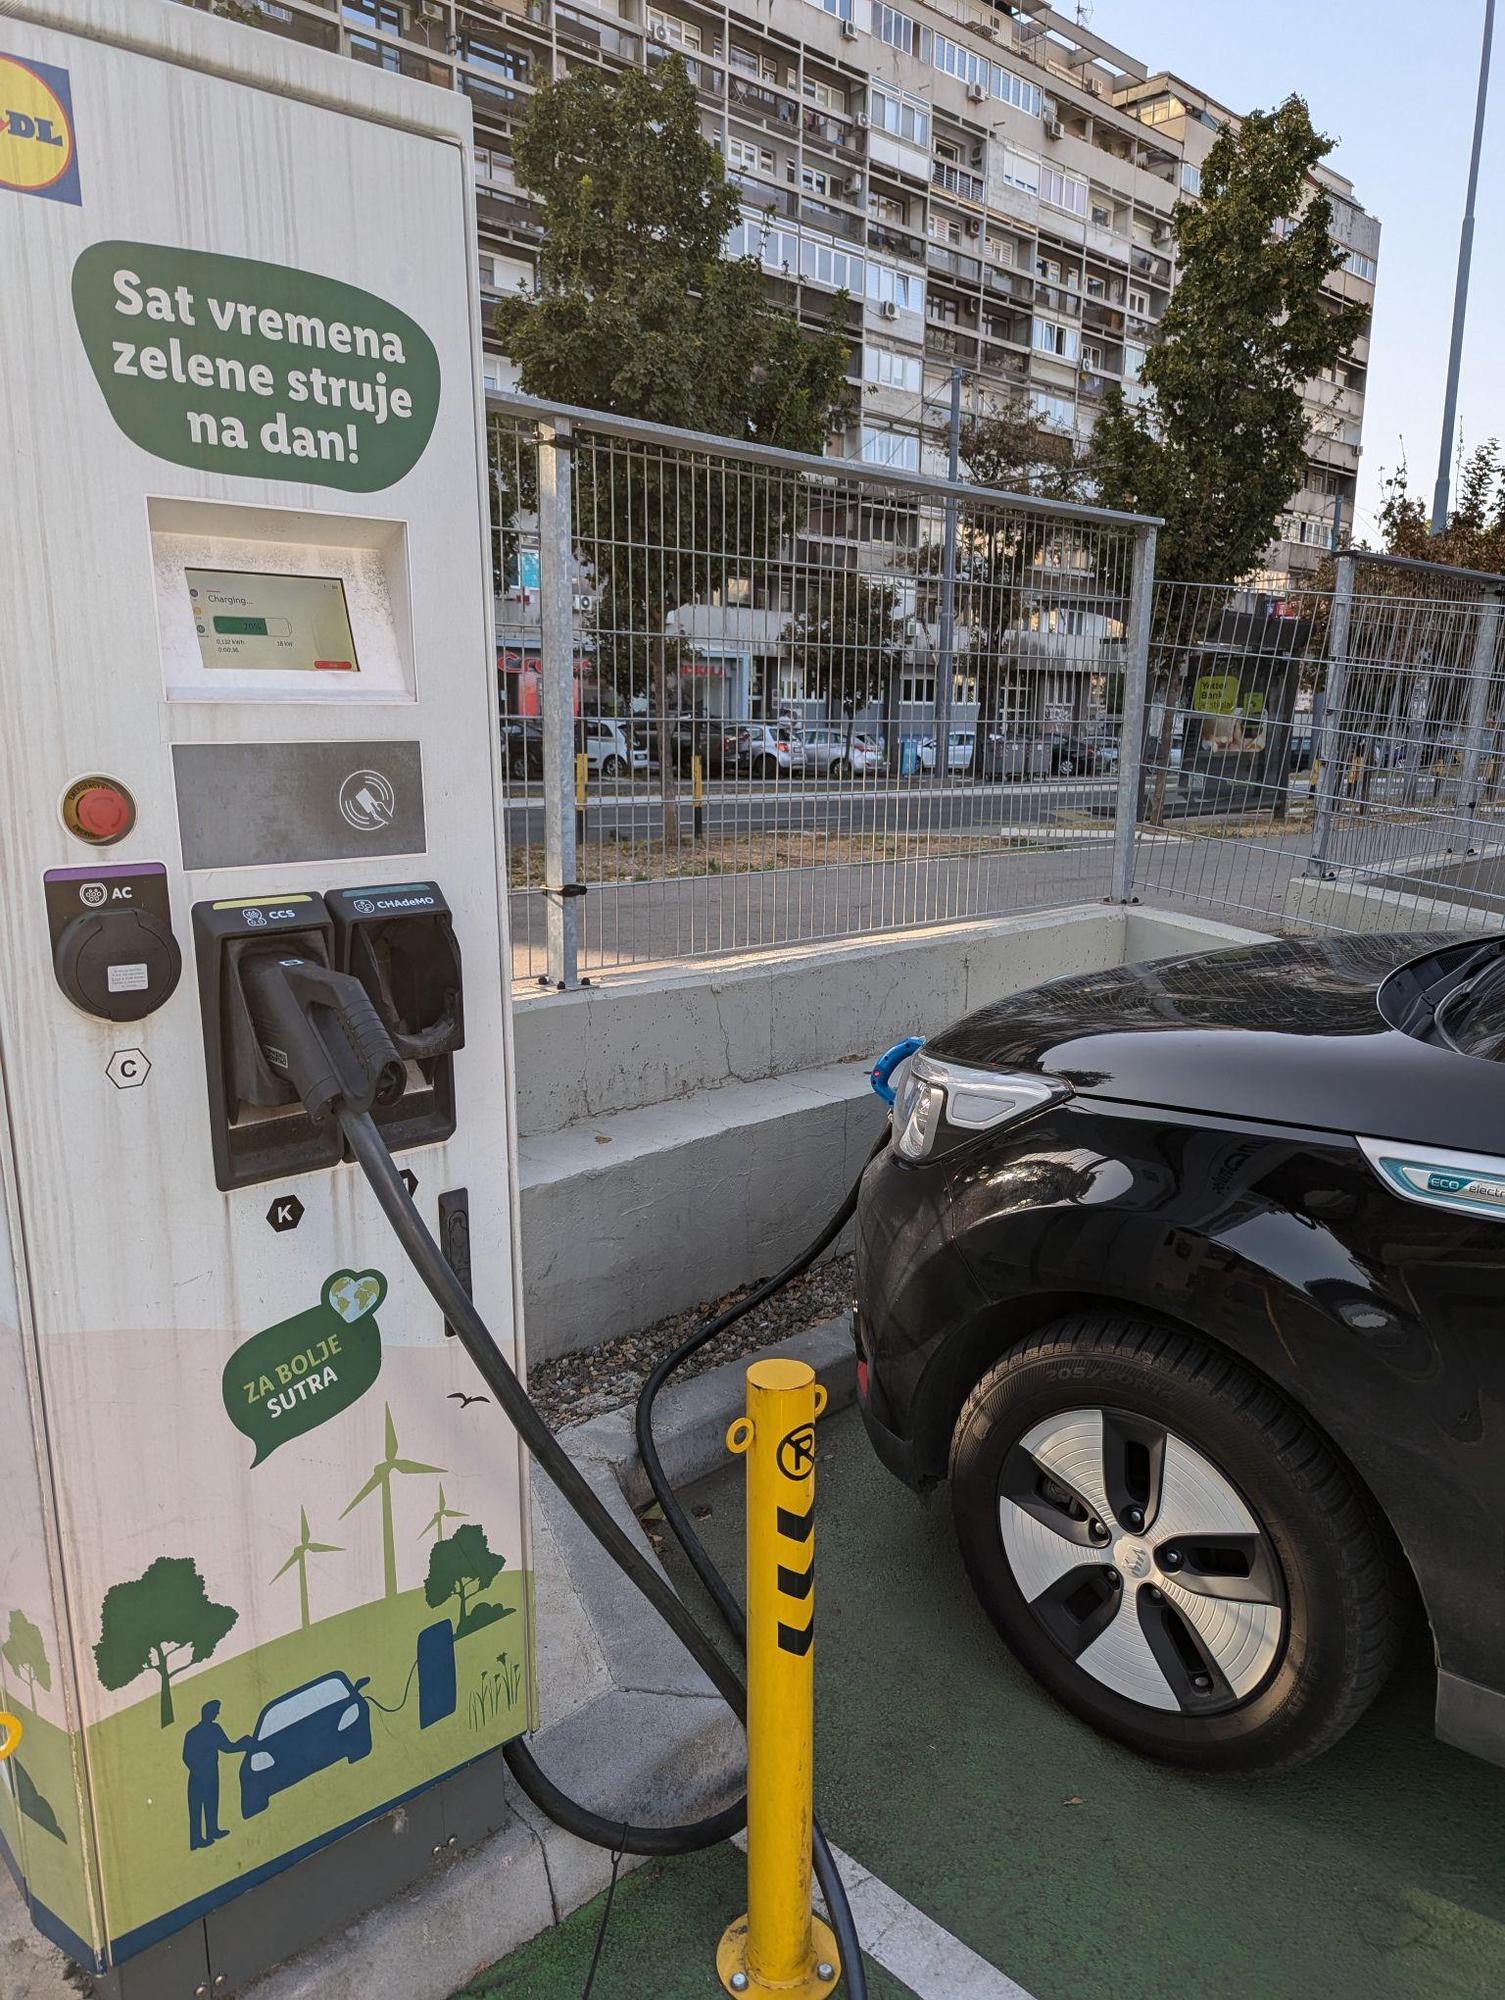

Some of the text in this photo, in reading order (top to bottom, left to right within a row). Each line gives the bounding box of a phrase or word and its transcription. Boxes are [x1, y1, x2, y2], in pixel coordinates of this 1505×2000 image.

[0, 110, 63, 147] DL
[112, 269, 405, 364] Sat vremena
[112, 338, 412, 424] zelene struje
[187, 410, 359, 464] na dan!
[112, 886, 132, 900] AC
[377, 897, 434, 909] CHAdeMO
[268, 908, 295, 920] CCS
[121, 1061, 137, 1078] C
[1431, 1178, 1459, 1190] ECO
[277, 1204, 293, 1223] K
[243, 1334, 342, 1404] ZA BOLJE
[266, 1365, 338, 1419] SUTRA
